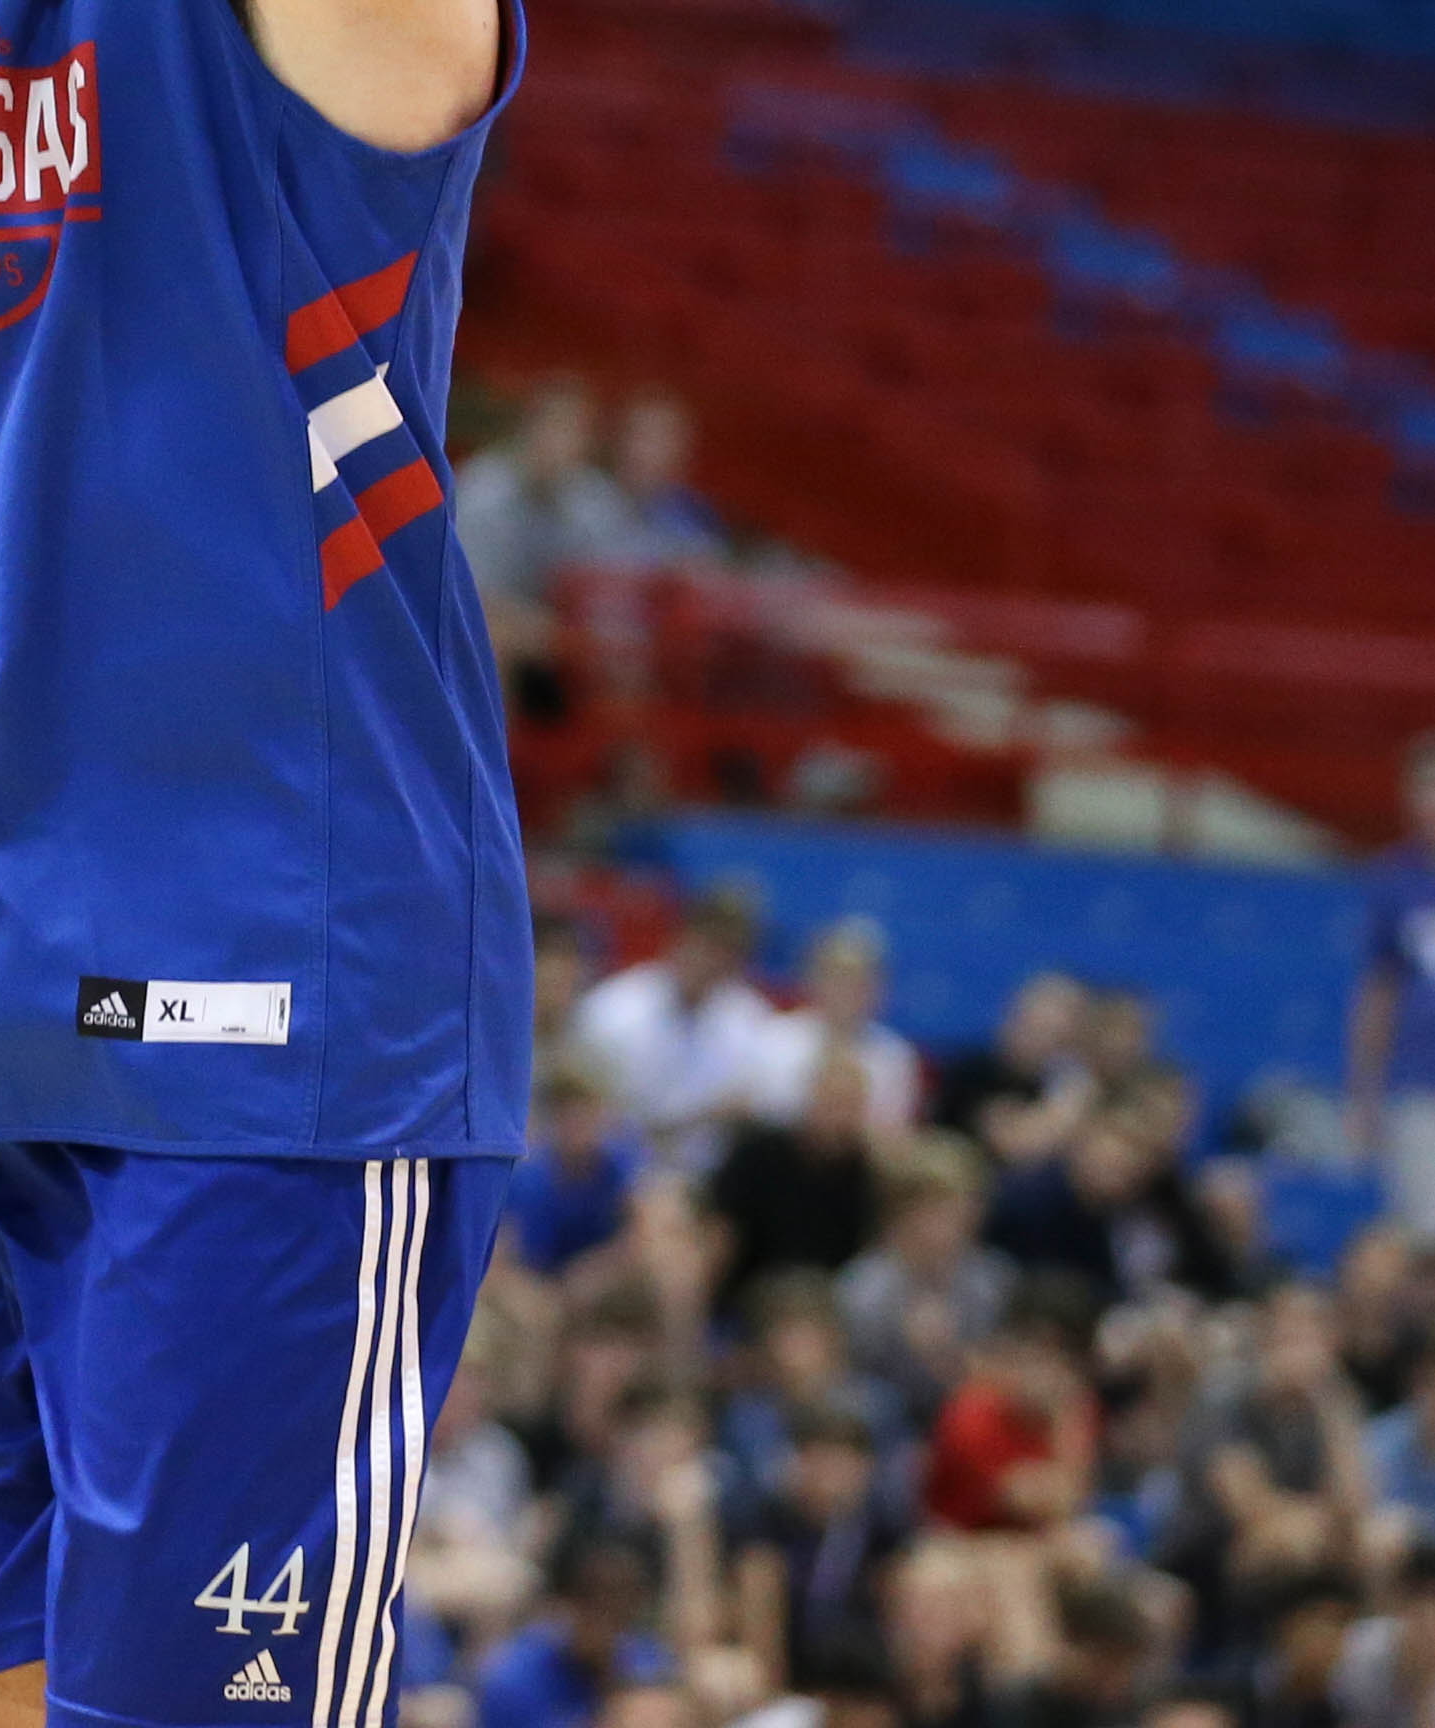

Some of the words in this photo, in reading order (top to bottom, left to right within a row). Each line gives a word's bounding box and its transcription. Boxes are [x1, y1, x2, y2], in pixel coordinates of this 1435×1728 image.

[83, 1010, 136, 1029] adidas
[158, 999, 195, 1022] XL
[193, 1541, 311, 1636] 44
[223, 1680, 292, 1703] adidas
